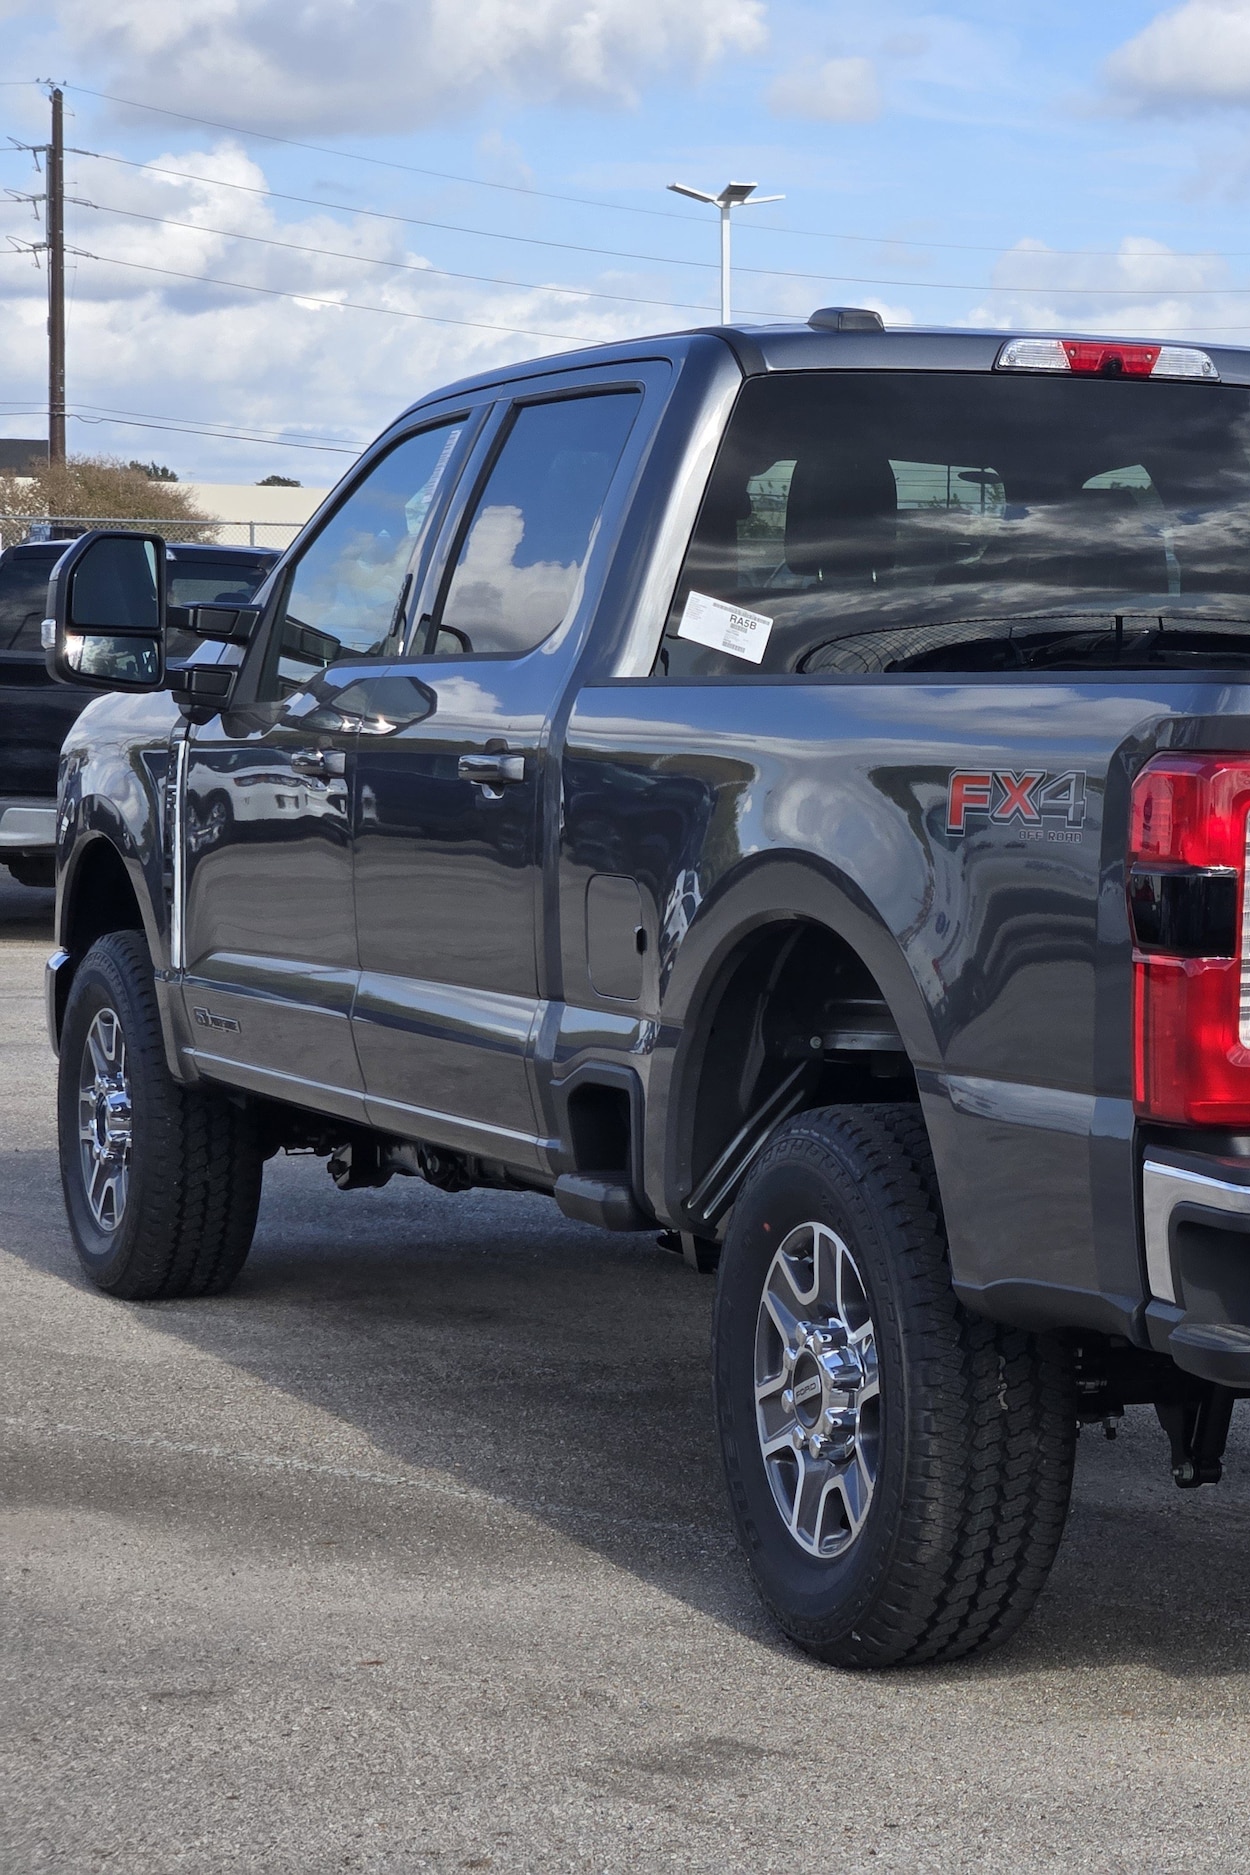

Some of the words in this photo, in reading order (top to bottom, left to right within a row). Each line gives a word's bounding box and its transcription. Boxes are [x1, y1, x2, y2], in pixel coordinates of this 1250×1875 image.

[729, 614, 757, 630] RA5B
[945, 767, 1087, 837] FX4
[1019, 829, 1044, 841] OFF
[1048, 831, 1083, 844] ROAD
[796, 1382, 817, 1397] FORD
